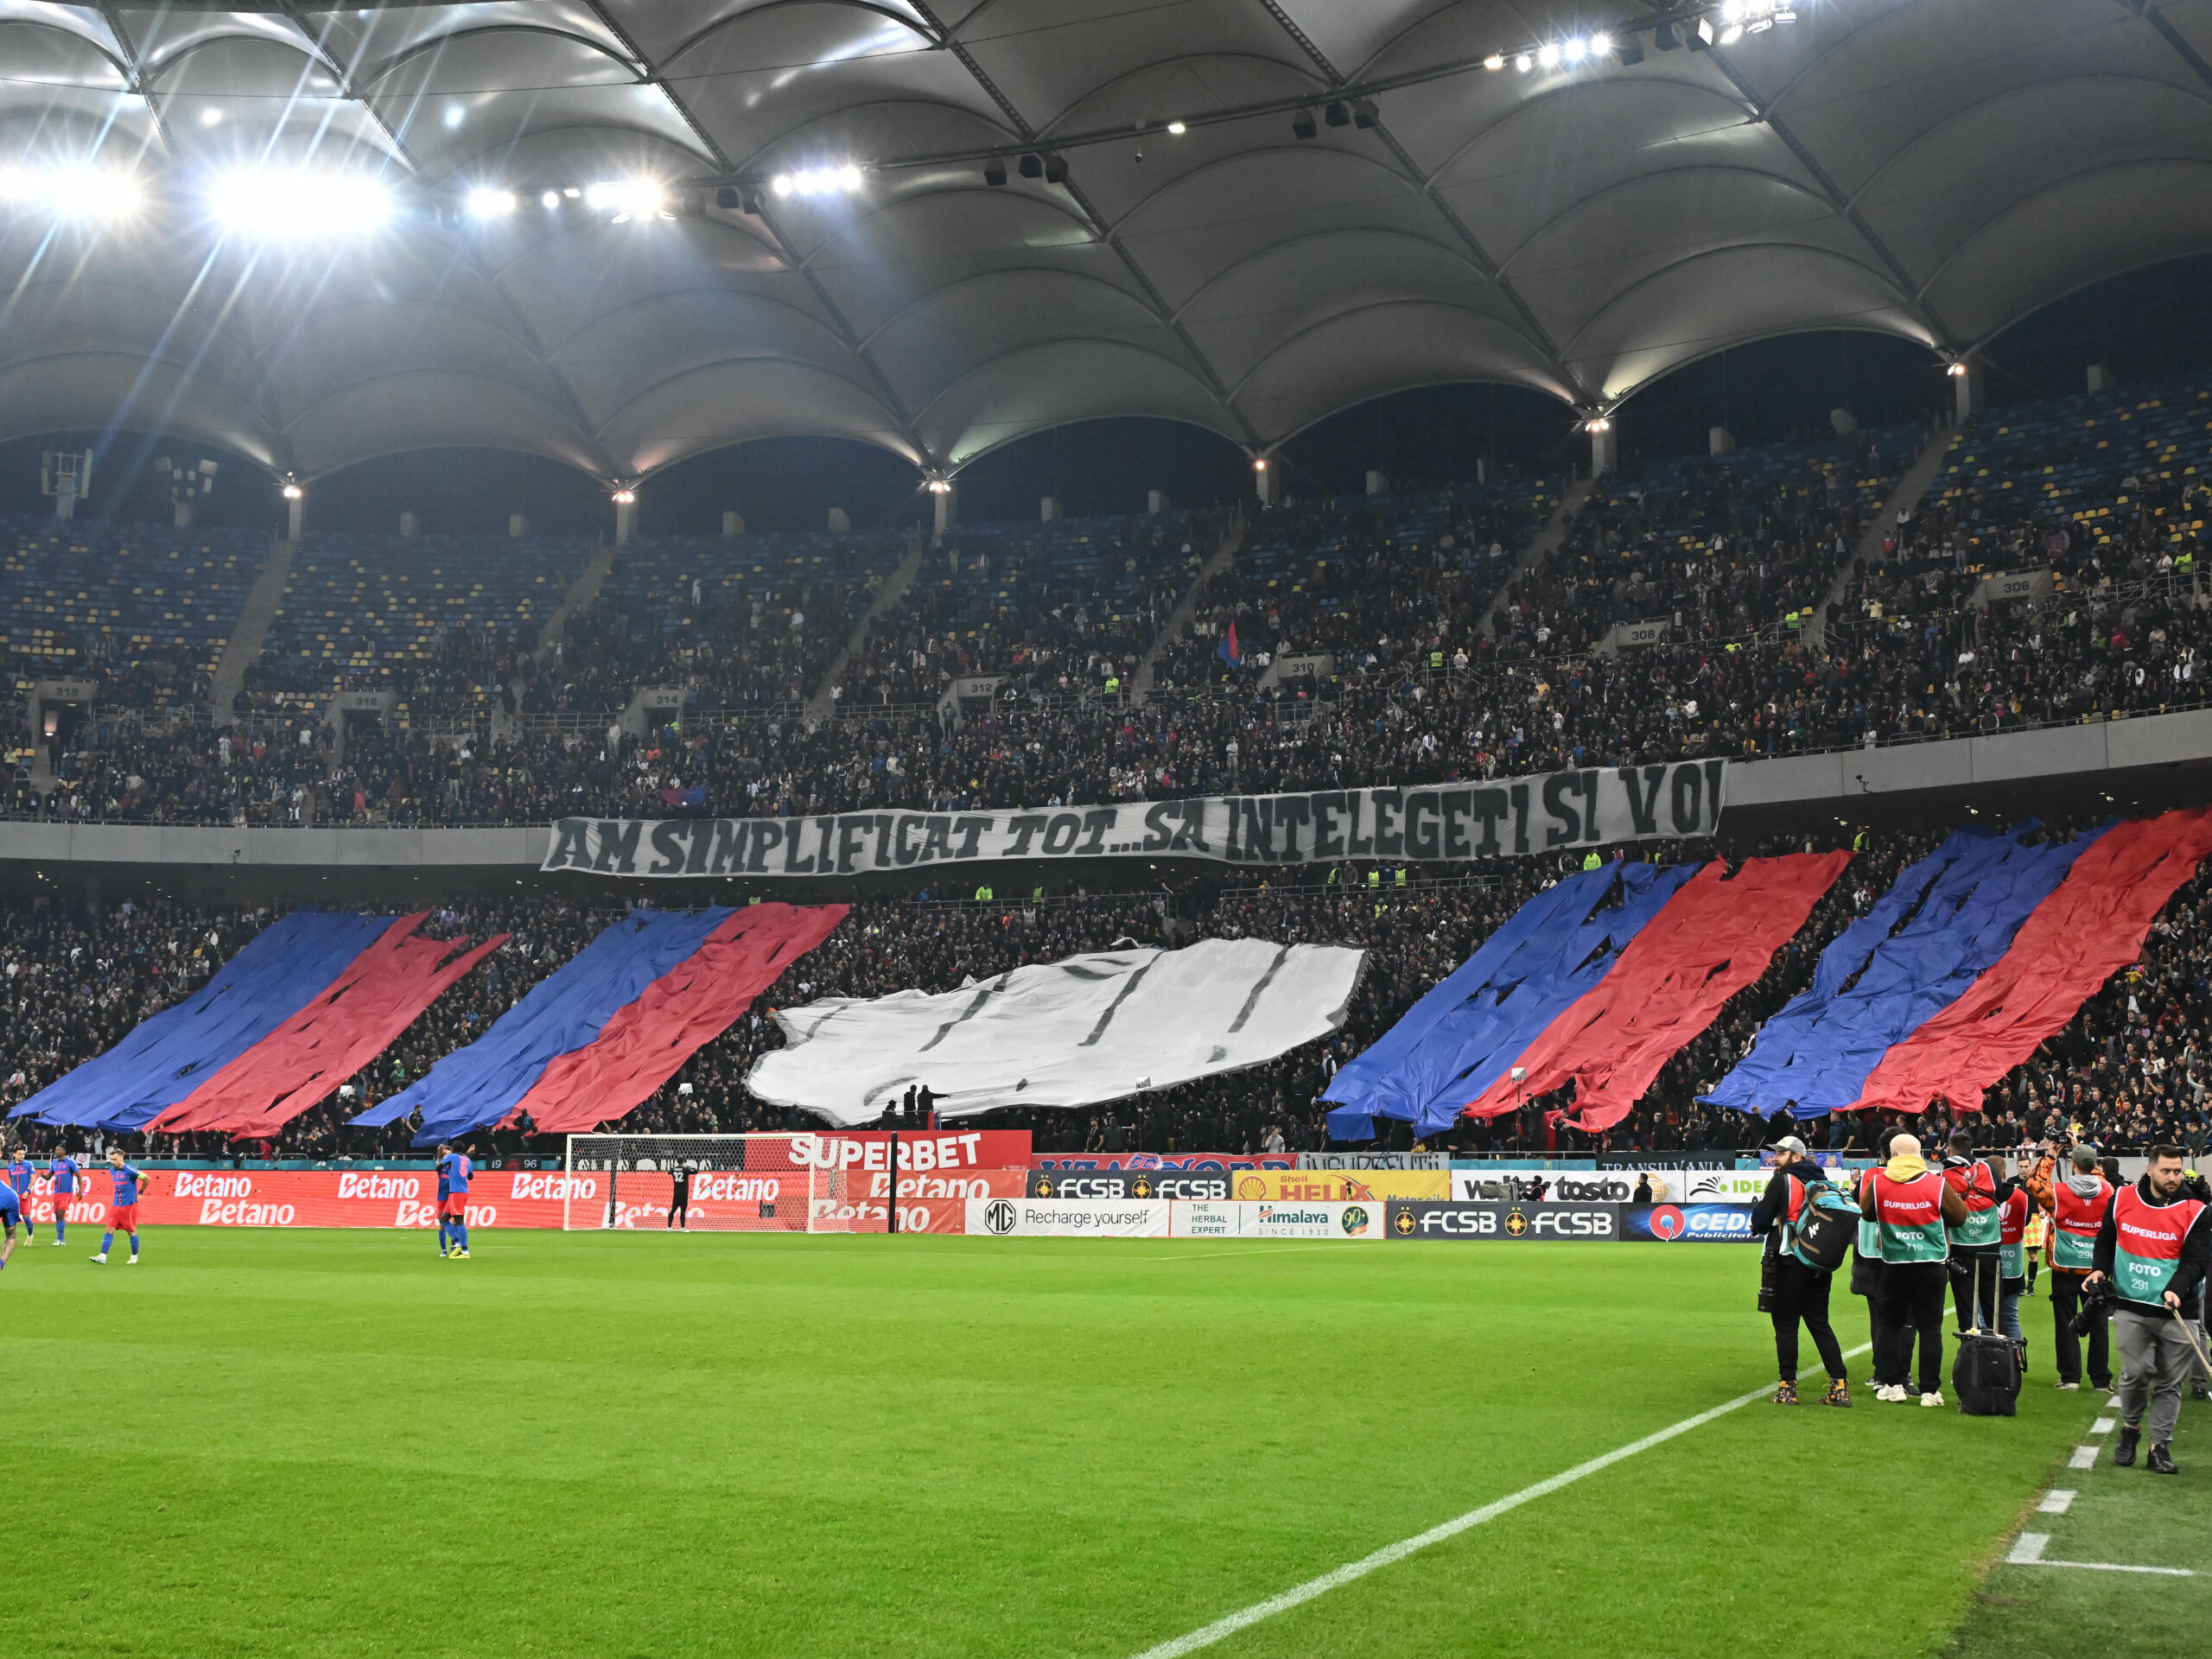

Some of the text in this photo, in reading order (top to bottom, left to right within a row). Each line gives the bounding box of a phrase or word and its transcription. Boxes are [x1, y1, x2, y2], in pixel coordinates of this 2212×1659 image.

[2004, 581, 2030, 593] 306
[1631, 629, 1655, 640] 308
[1292, 663, 1315, 672] 310
[971, 683, 992, 692] 312
[355, 697, 378, 706] 316
[656, 696, 678, 704] 314
[547, 820, 643, 873] AM
[649, 814, 995, 874] SIMPLIFICAT
[1224, 784, 1529, 861] INTELEGETI
[1542, 769, 1601, 846] SI
[789, 1133, 982, 1171] SUPERBET
[492, 1160, 537, 1168] 19 96
[174, 1172, 251, 1198] Betano
[338, 1173, 419, 1198] Betano
[511, 1173, 596, 1199] Betano
[672, 1172, 684, 1183] 32
[692, 1173, 779, 1200] Betano
[869, 1173, 990, 1199] Betano
[1057, 1179, 1125, 1198] FCSB
[1154, 1179, 1226, 1199] FCSB
[1279, 1185, 1370, 1200] HELIX
[1554, 1175, 1630, 1201] tosto
[199, 1198, 295, 1225] Betano
[395, 1200, 497, 1227] Beno
[1884, 1199, 1932, 1210] SUPERLIGA
[987, 1202, 1014, 1231] MG
[1026, 1209, 1149, 1228] Recharge yourself
[1258, 1205, 1329, 1224] Himalaya
[1420, 1211, 1497, 1233] FCSB
[1531, 1211, 1612, 1235] FCSB
[2064, 1218, 2102, 1228] SUPERLIG
[1895, 1231, 1925, 1240] FOTO
[2120, 1223, 2177, 1241] SUPERLIGA
[2128, 1262, 2161, 1276] FOTO
[2131, 1278, 2149, 1291] 291
